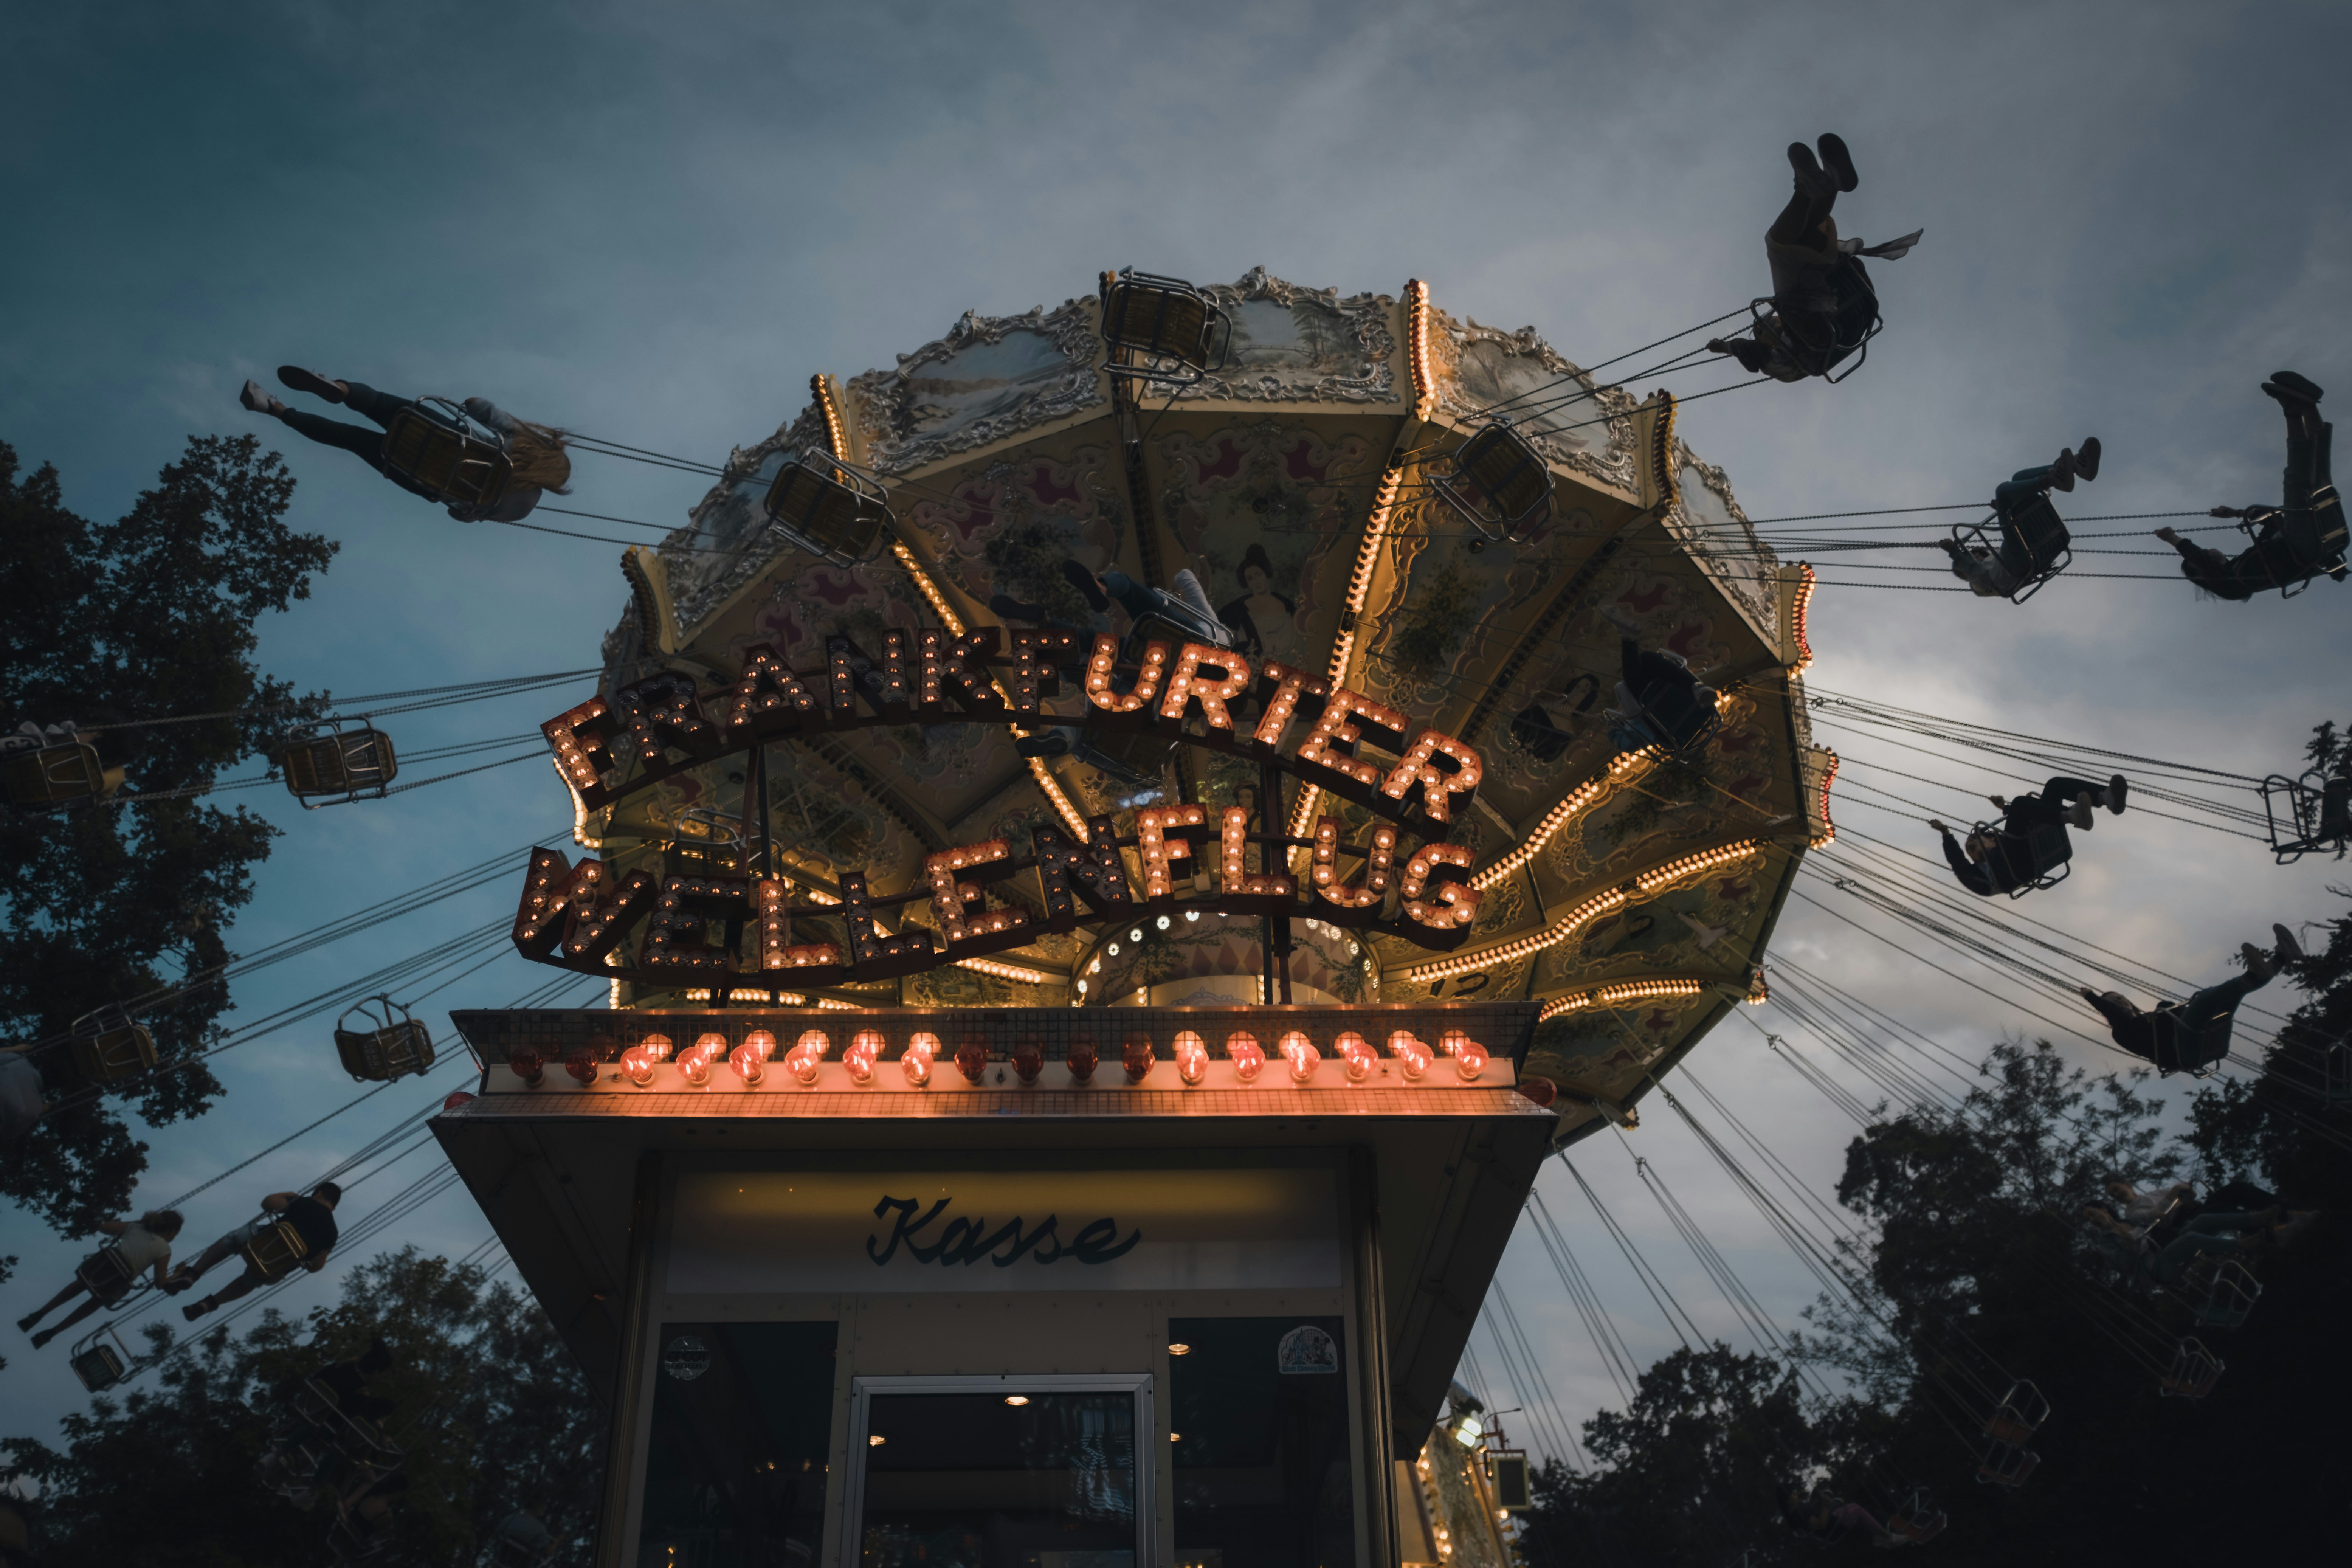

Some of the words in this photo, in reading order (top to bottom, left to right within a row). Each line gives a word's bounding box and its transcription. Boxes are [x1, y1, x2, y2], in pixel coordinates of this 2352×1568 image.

[540, 627, 1483, 830] FRANKFURTER
[511, 803, 1483, 976] WELLENFLUG
[867, 1195, 1141, 1267] Kasse
